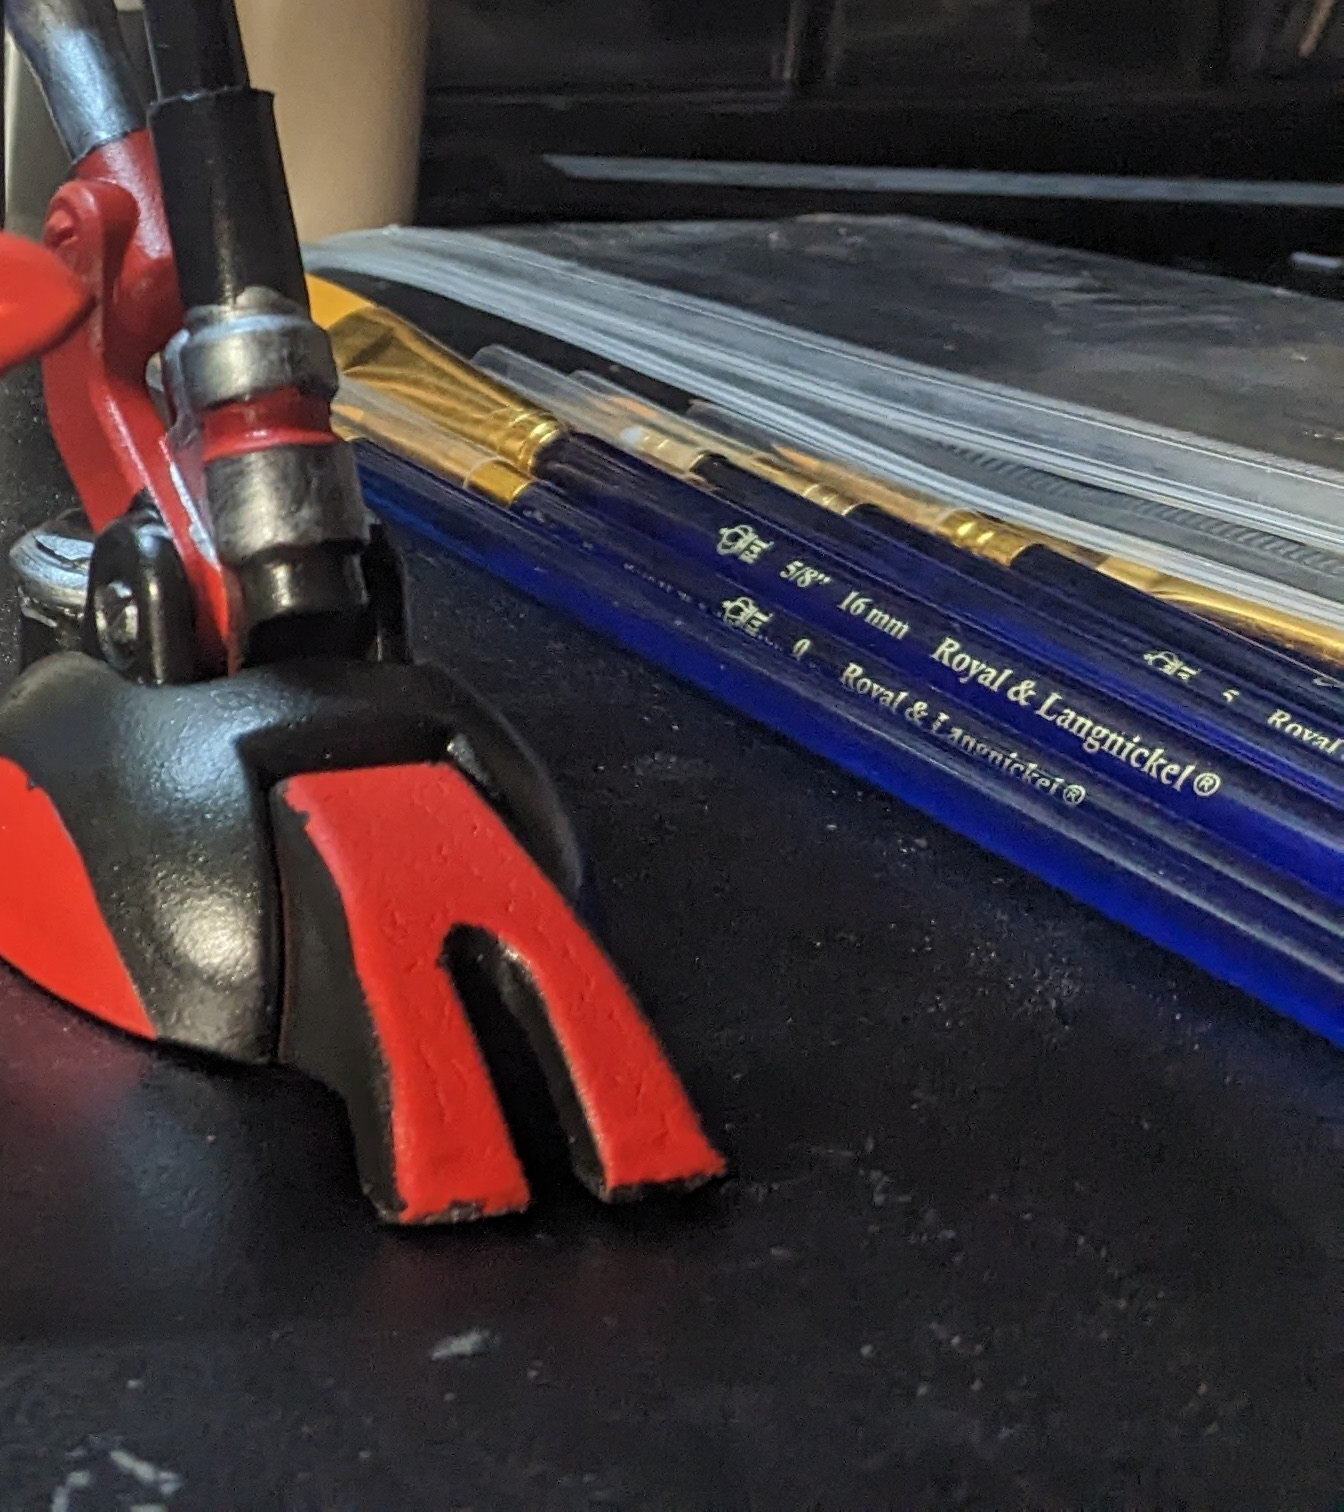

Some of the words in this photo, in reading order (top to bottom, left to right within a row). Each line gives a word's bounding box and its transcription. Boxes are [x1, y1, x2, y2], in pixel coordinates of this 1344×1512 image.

[837, 590, 874, 616] 16
[864, 606, 911, 641] mm
[929, 635, 1013, 694] Royal
[1006, 680, 1039, 707] &
[1035, 691, 1198, 792] Langnickel
[838, 661, 909, 714] Royal
[905, 700, 930, 724] &
[929, 710, 1066, 797] Langnickel
